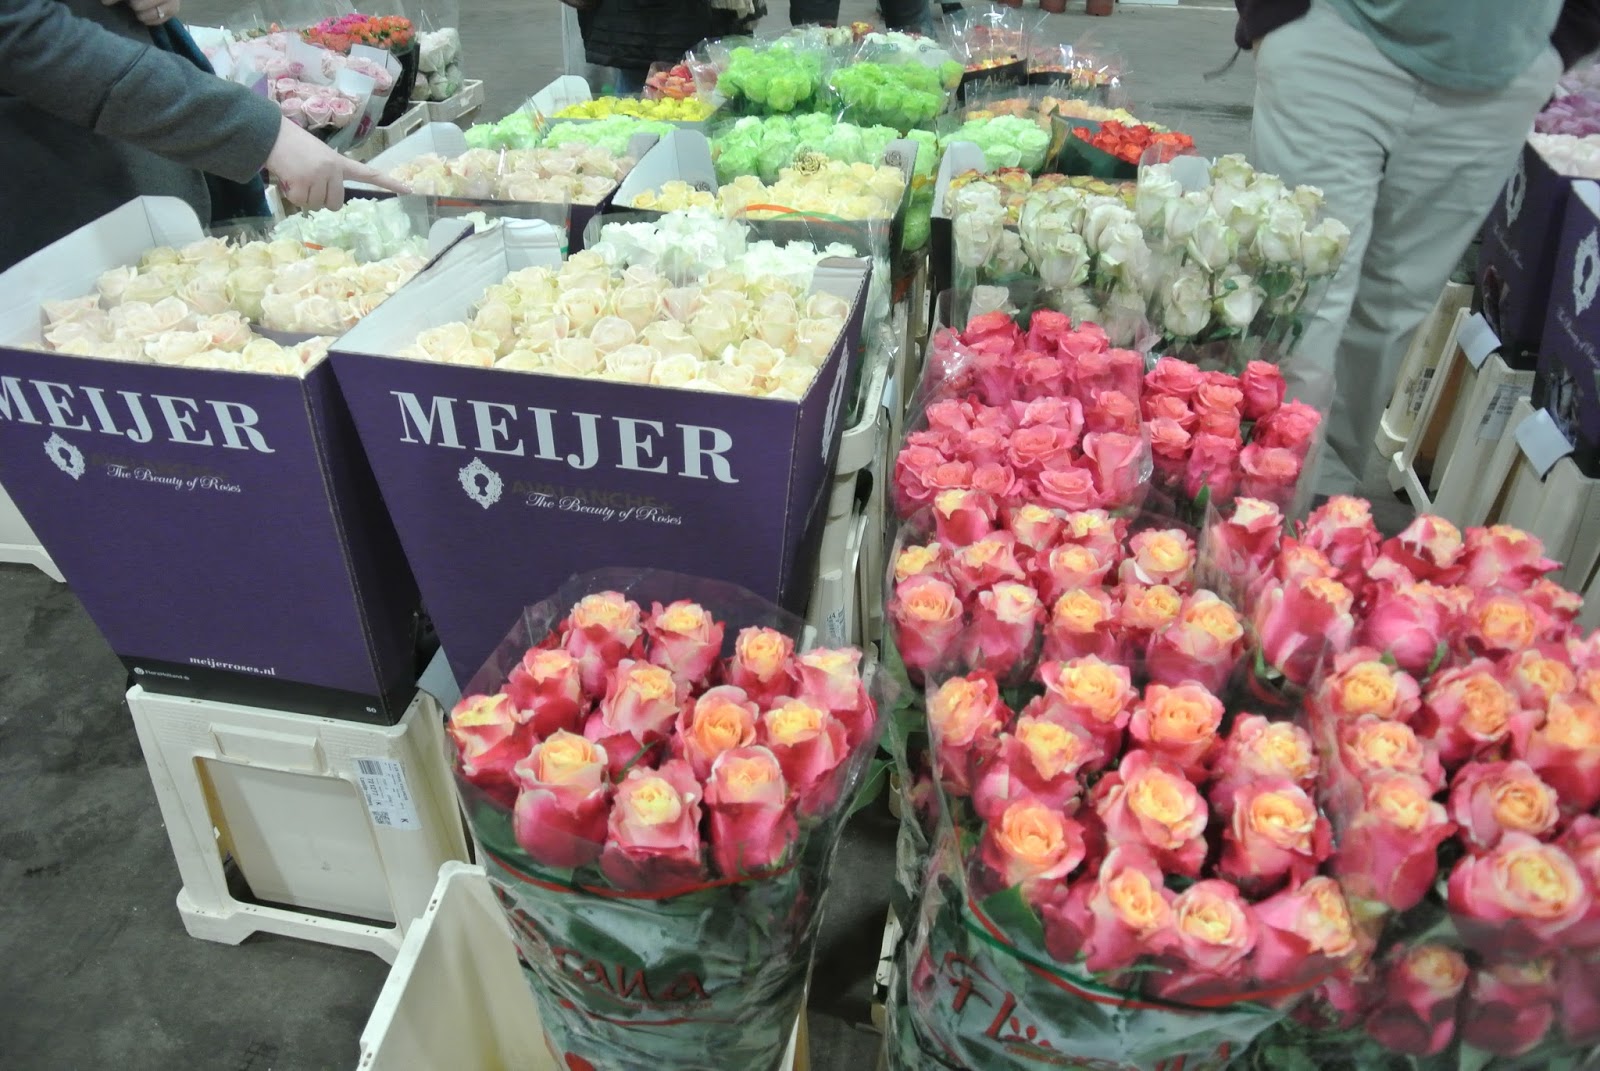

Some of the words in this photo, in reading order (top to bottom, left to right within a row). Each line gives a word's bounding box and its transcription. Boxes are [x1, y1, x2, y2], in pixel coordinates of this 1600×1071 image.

[0, 376, 275, 453] MEIJER
[390, 391, 739, 483] MEIJER
[105, 463, 131, 479] The
[134, 467, 183, 490] Beauty
[186, 477, 199, 491] of
[200, 475, 241, 493] Roses
[525, 491, 554, 508] The
[559, 496, 615, 522] Beauty
[618, 506, 636, 522] of
[635, 505, 682, 525] Roses
[189, 656, 276, 676] meijerroses.nl
